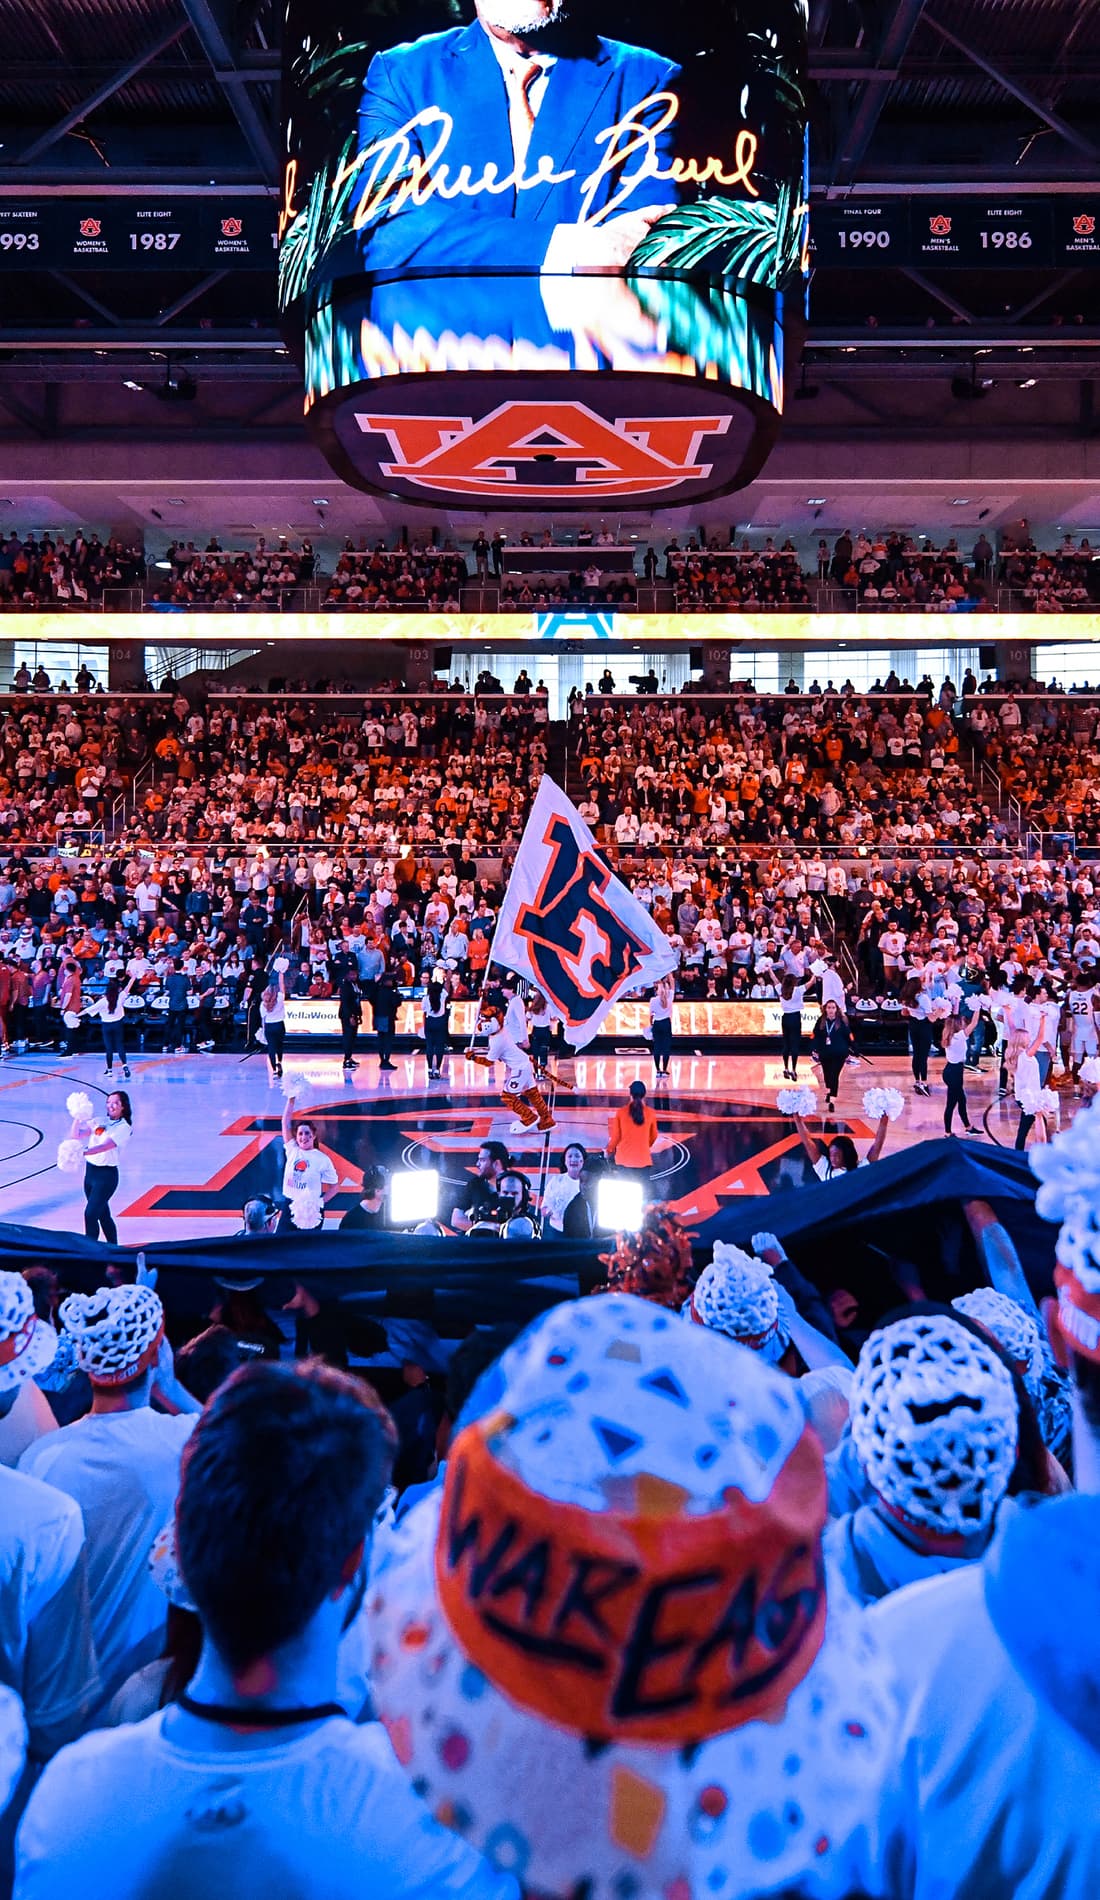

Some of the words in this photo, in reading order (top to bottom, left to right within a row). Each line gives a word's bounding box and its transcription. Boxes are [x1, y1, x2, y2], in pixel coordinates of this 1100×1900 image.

[129, 233, 182, 250] 1987
[838, 231, 890, 248] 1990
[980, 231, 1032, 249] 1986
[922, 244, 960, 252] BASKETBALL
[112, 650, 131, 661] 104
[409, 649, 429, 661] 103
[708, 650, 729, 661] 102
[1072, 1001, 1089, 1016] 22
[446, 1452, 644, 1642] WAR
